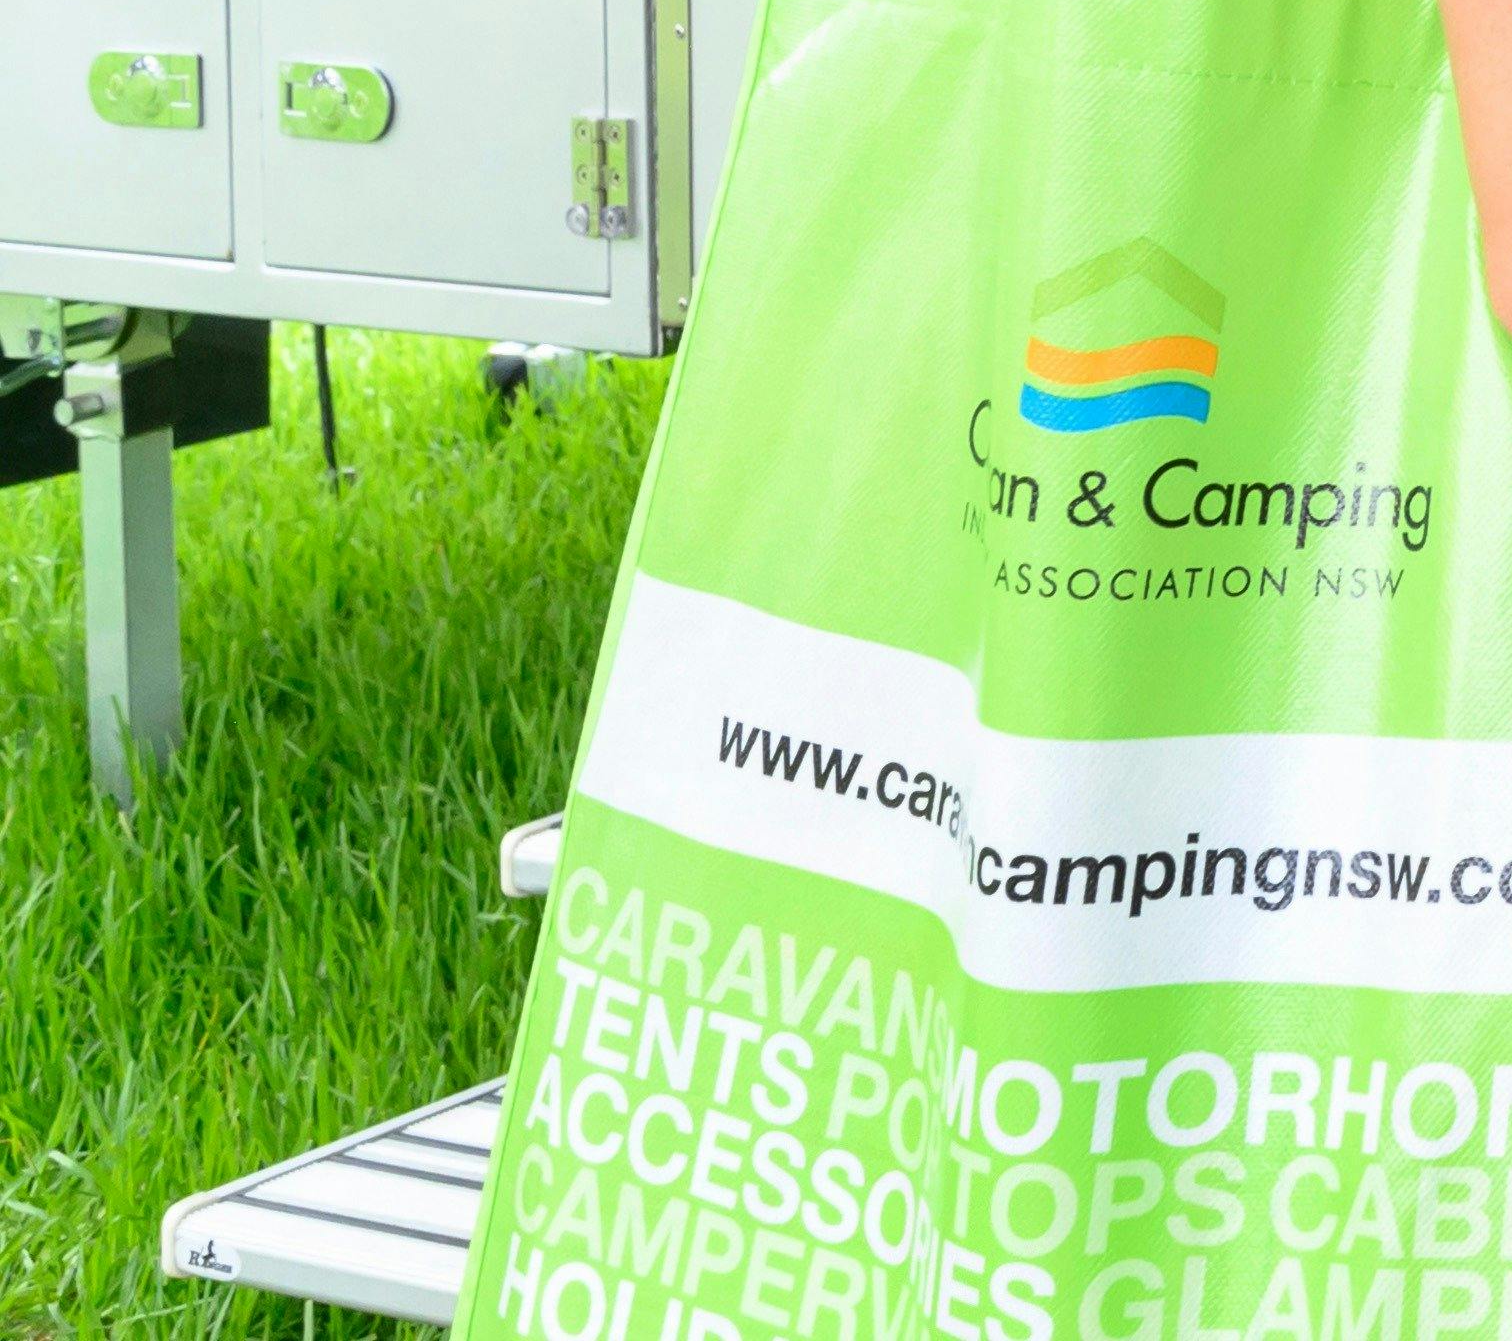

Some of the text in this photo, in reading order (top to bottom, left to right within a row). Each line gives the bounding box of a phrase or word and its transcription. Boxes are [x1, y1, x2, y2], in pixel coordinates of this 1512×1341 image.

[993, 558, 1405, 602] ASSOCIATION NSW
[1066, 469, 1117, 529] &
[1142, 457, 1433, 552] Camping
[555, 865, 950, 1099] CARAVANS
[523, 1051, 1058, 1341] ACCESSORIES
[551, 955, 815, 1127] TENTS
[946, 1139, 1247, 1260] TOPS
